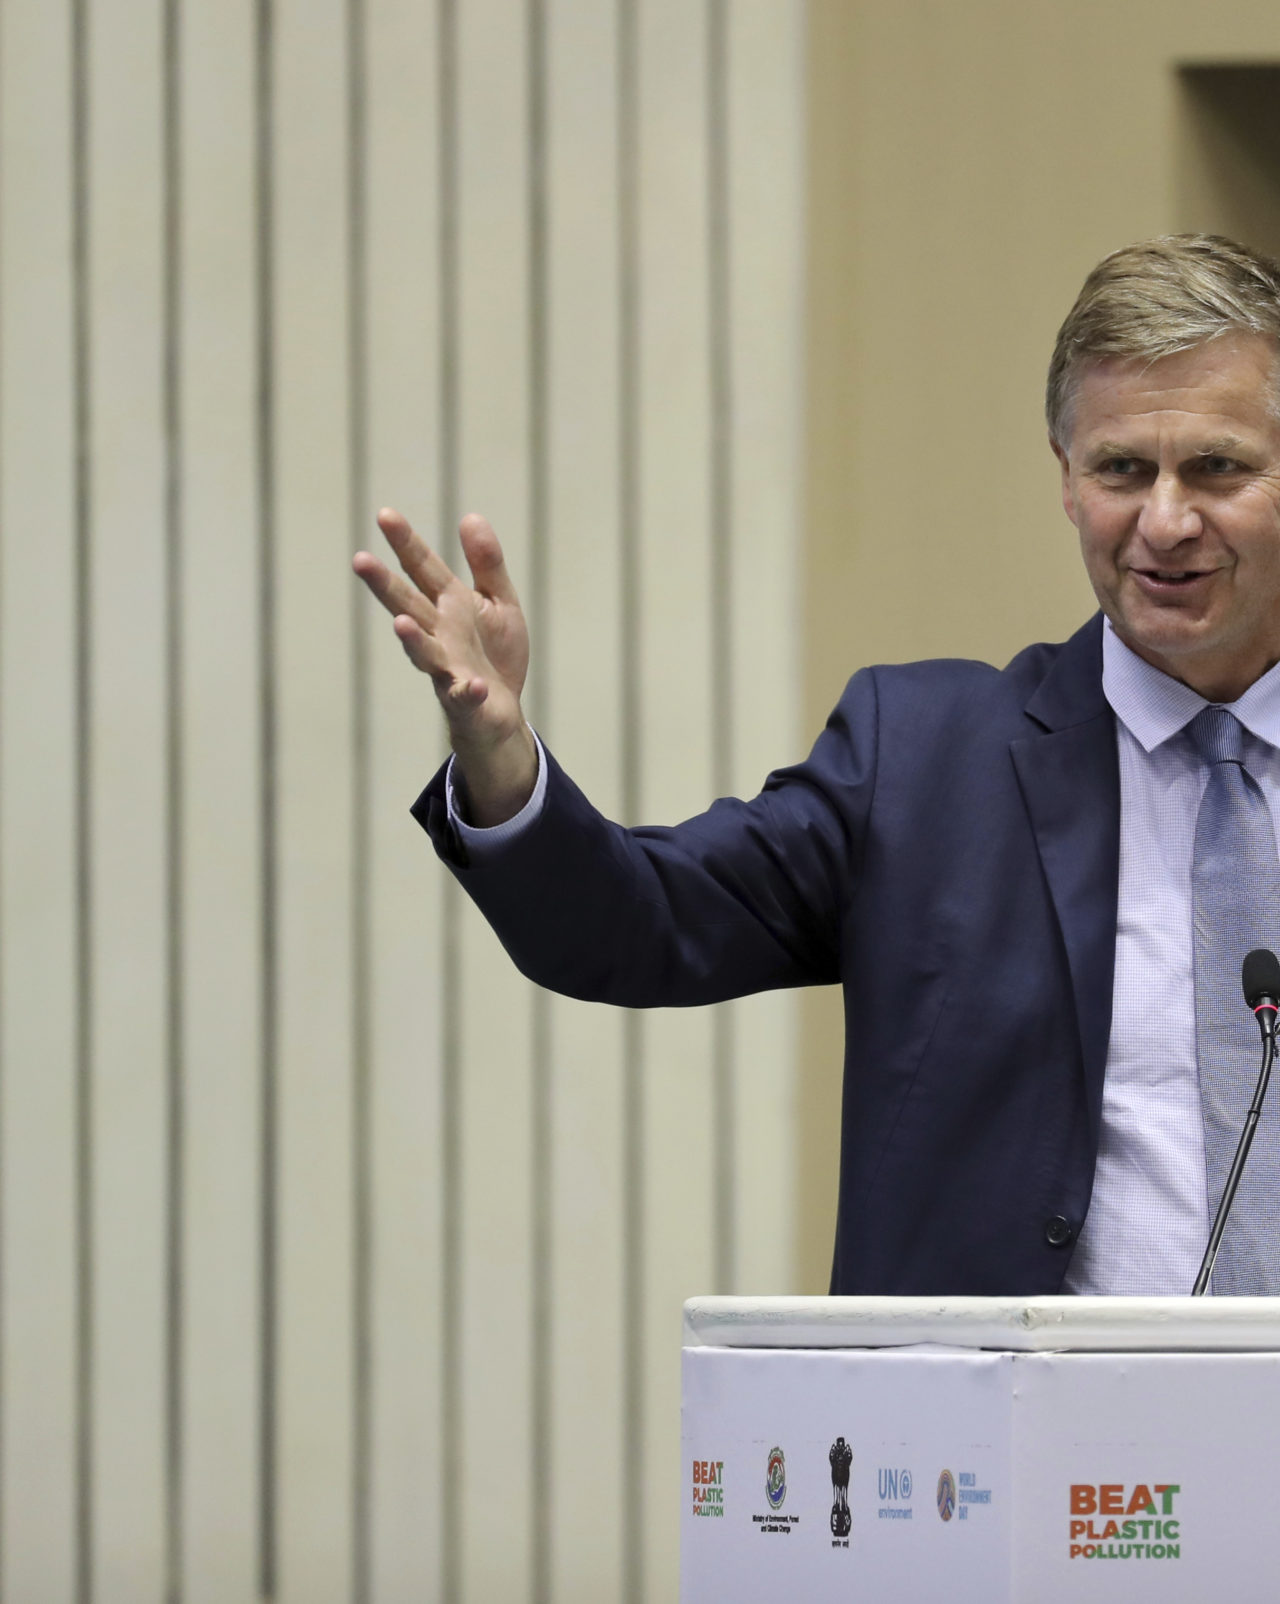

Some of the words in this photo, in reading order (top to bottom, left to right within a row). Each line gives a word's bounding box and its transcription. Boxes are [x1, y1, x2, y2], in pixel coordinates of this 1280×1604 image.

[693, 1460, 724, 1485] BEAT
[878, 1468, 898, 1500] UN
[693, 1487, 724, 1503] PLASTIC
[1070, 1484, 1181, 1515] BEAT
[693, 1504, 724, 1518] POLLUTION
[1070, 1520, 1180, 1540] PLASTIC
[1070, 1544, 1180, 1559] POLLUTION
